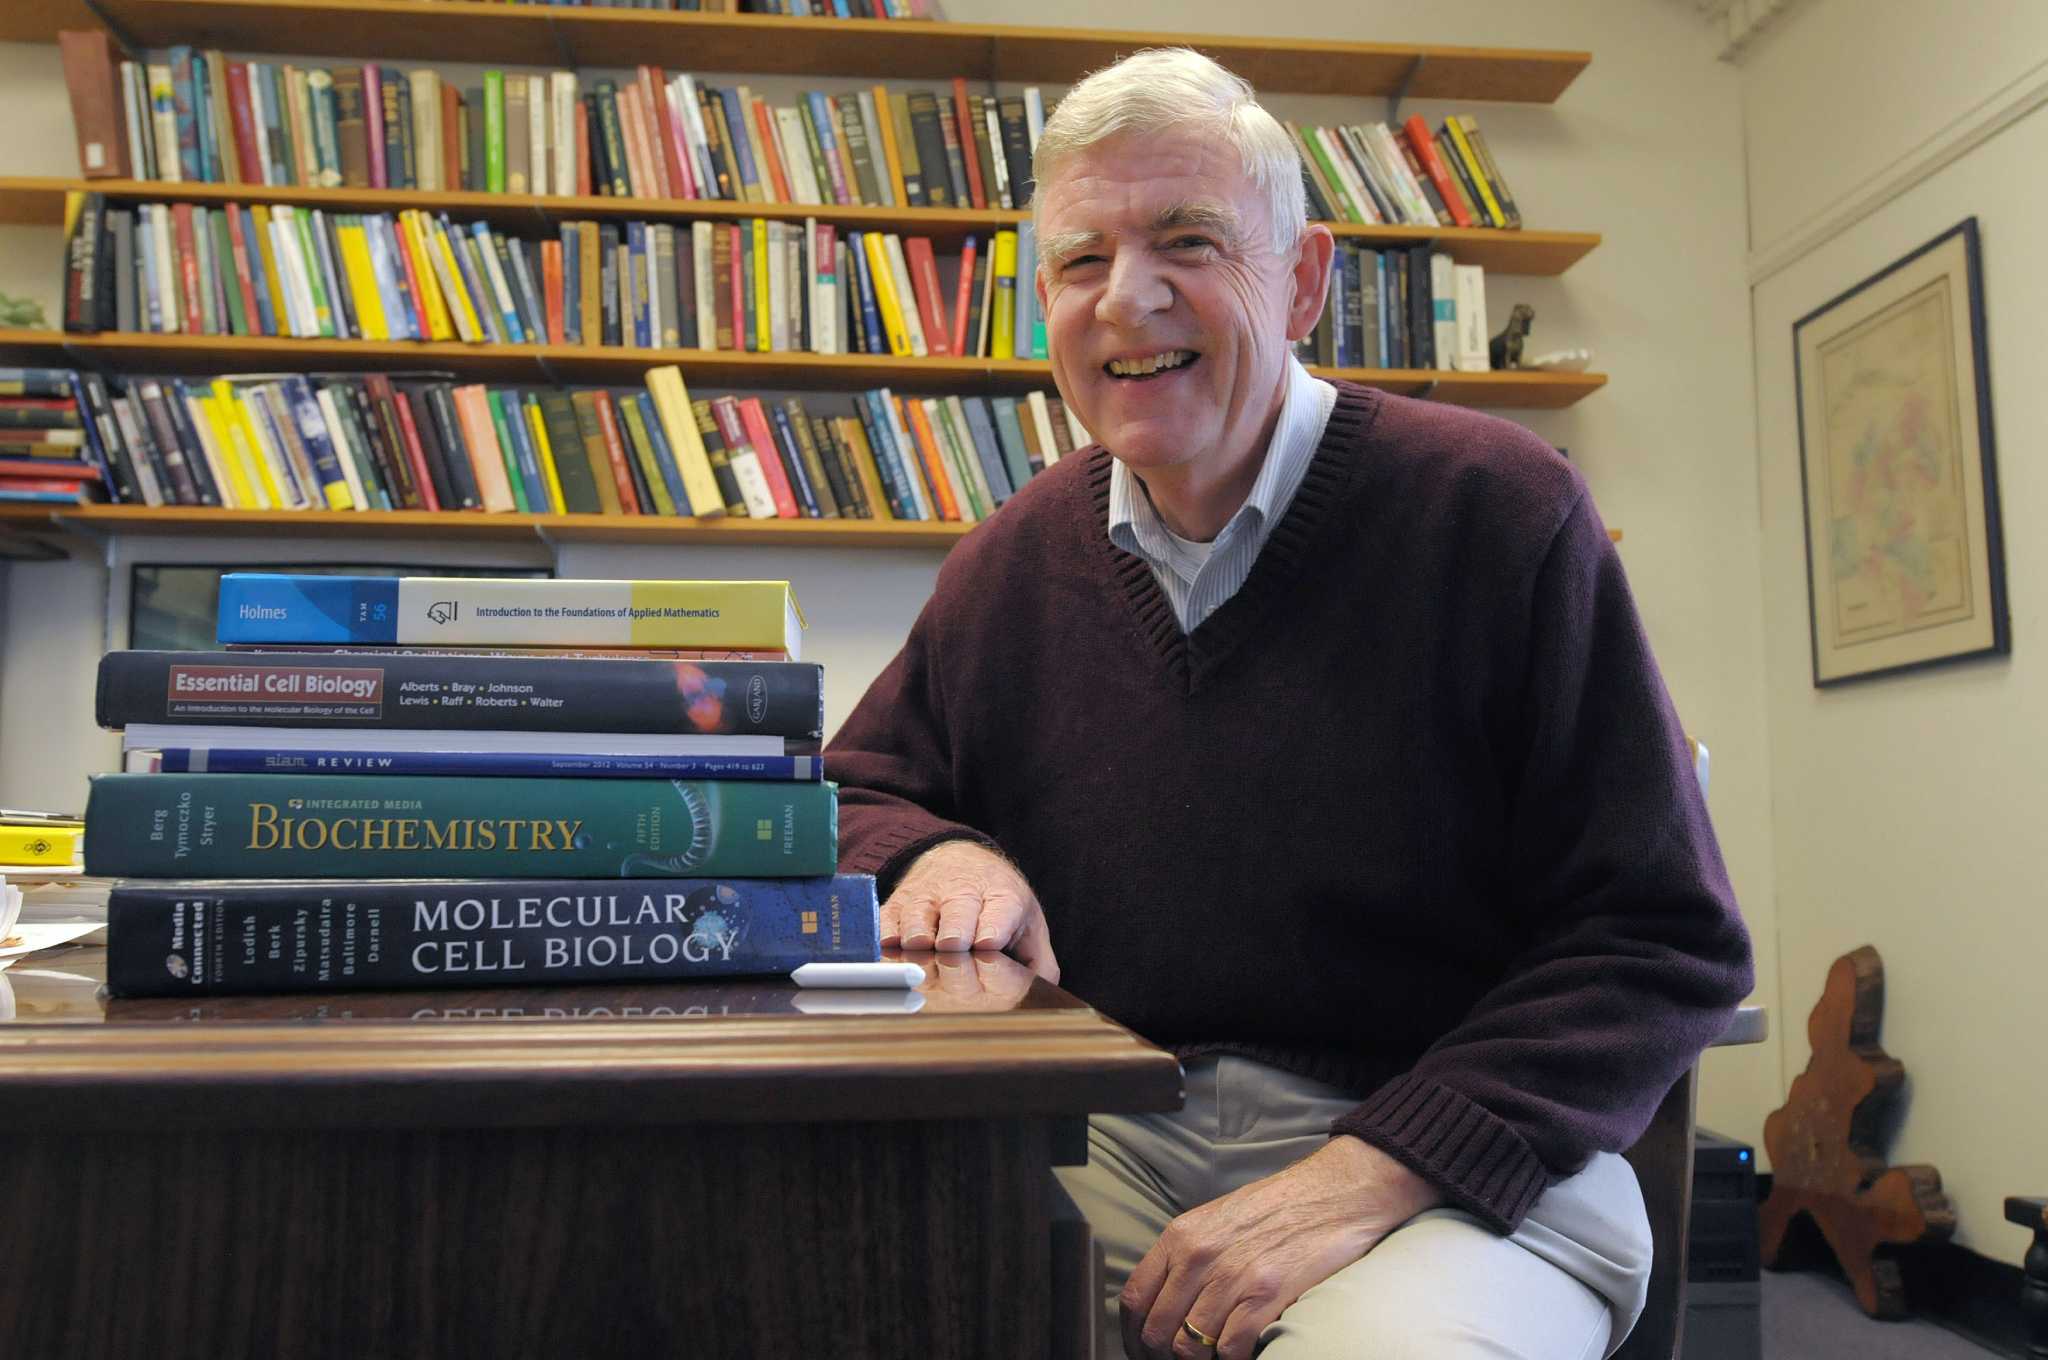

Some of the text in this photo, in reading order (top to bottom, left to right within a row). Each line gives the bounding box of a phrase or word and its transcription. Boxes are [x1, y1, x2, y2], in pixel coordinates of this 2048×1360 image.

[240, 604, 288, 620] Holmes
[360, 602, 368, 622] TAM
[373, 603, 387, 622] 56
[476, 606, 720, 620] Introduction to the Foundations of Applied Mathematics
[175, 673, 377, 698] Essential Cell Biology
[400, 682, 534, 694] Alberts Bray Johnson
[400, 696, 564, 708] Lewis Raff Roberts Walter
[752, 678, 762, 720] GARLAND
[187, 705, 237, 713] Introduction
[263, 706, 303, 714] Molecular
[303, 707, 333, 715] Biology
[334, 706, 345, 714] of
[345, 706, 359, 714] the
[359, 707, 375, 715] Cell
[317, 757, 393, 768] REVIEW
[593, 760, 611, 769] 2012
[614, 760, 643, 769] Volume
[704, 762, 726, 771] Pages
[306, 799, 424, 810] INTEGRATED MEDIA
[151, 809, 169, 841] Berg
[174, 792, 192, 860] Tymoczko
[200, 805, 217, 846] Stryer
[246, 802, 583, 851] BIOCHEMISTRY
[636, 813, 647, 844] FIFTH
[650, 806, 661, 851] EDITION
[783, 803, 795, 855] FREEMAN
[172, 902, 185, 949] Media
[412, 894, 689, 932] MOLECULAR
[831, 894, 841, 951] FREEMAN
[192, 902, 204, 984] Connected
[242, 915, 256, 965] Lodish
[267, 925, 281, 960] Berk
[293, 909, 309, 973] Zipursky
[318, 899, 332, 981] Matsudaira
[342, 903, 356, 975] Baltimore
[367, 908, 381, 963] Darnell
[411, 931, 738, 974] CELL BIOLOGY
